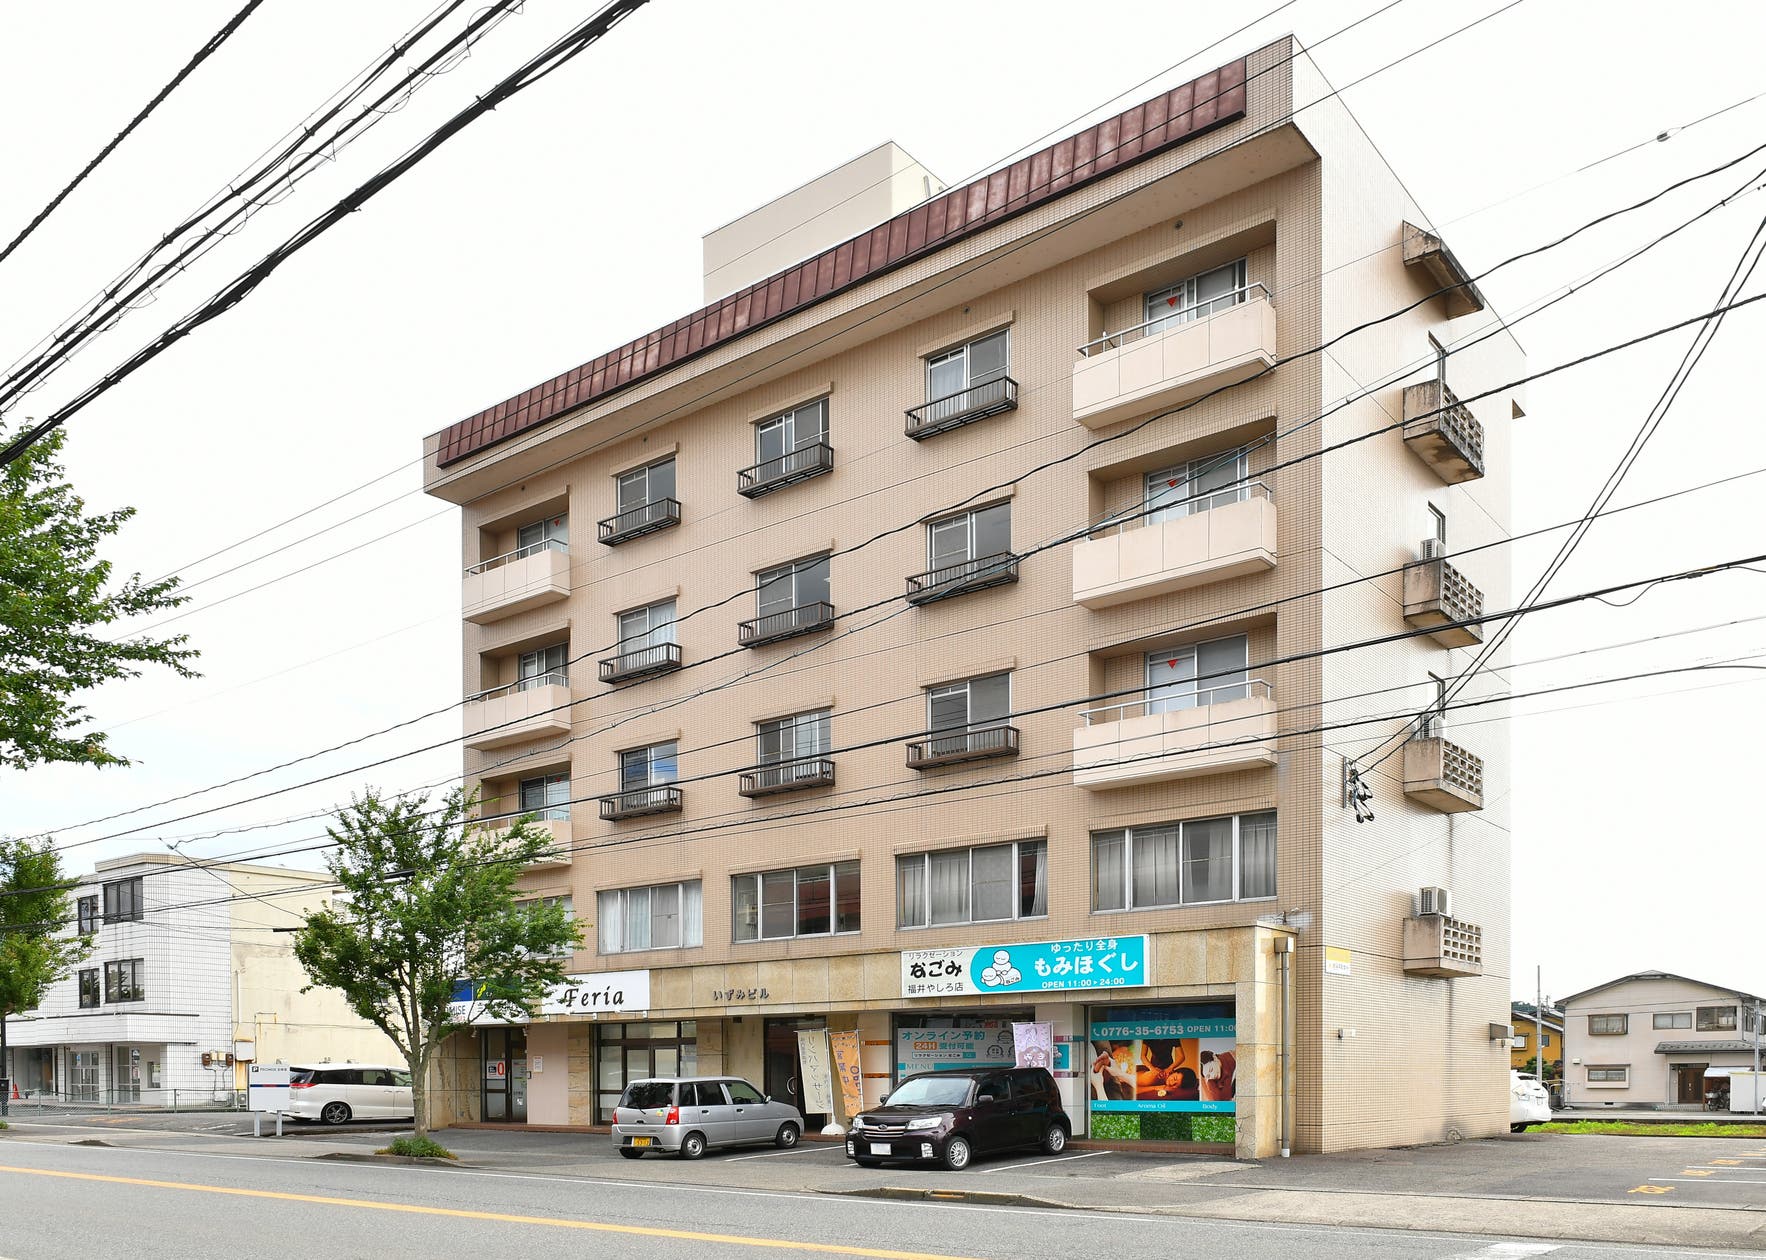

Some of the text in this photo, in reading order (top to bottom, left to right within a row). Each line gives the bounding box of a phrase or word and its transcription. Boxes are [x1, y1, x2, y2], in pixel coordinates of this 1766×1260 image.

[1051, 939, 1118, 954] ゆったり全身
[909, 950, 963, 961] リラクゼーション
[910, 960, 962, 979] なごみ
[1034, 952, 1139, 977] もみほぐし
[908, 982, 964, 994] 福井やしろ店
[1041, 977, 1125, 989] OPEN 11:00 24:00
[564, 985, 625, 1008] Feria
[713, 988, 769, 1001] いずみビル
[902, 1030, 986, 1042] オンライン予約
[1101, 1025, 1184, 1037] 0776-35-6753
[1187, 1025, 1211, 1033] OPEN
[915, 1042, 936, 1050] 24H
[906, 1063, 934, 1071] MENU
